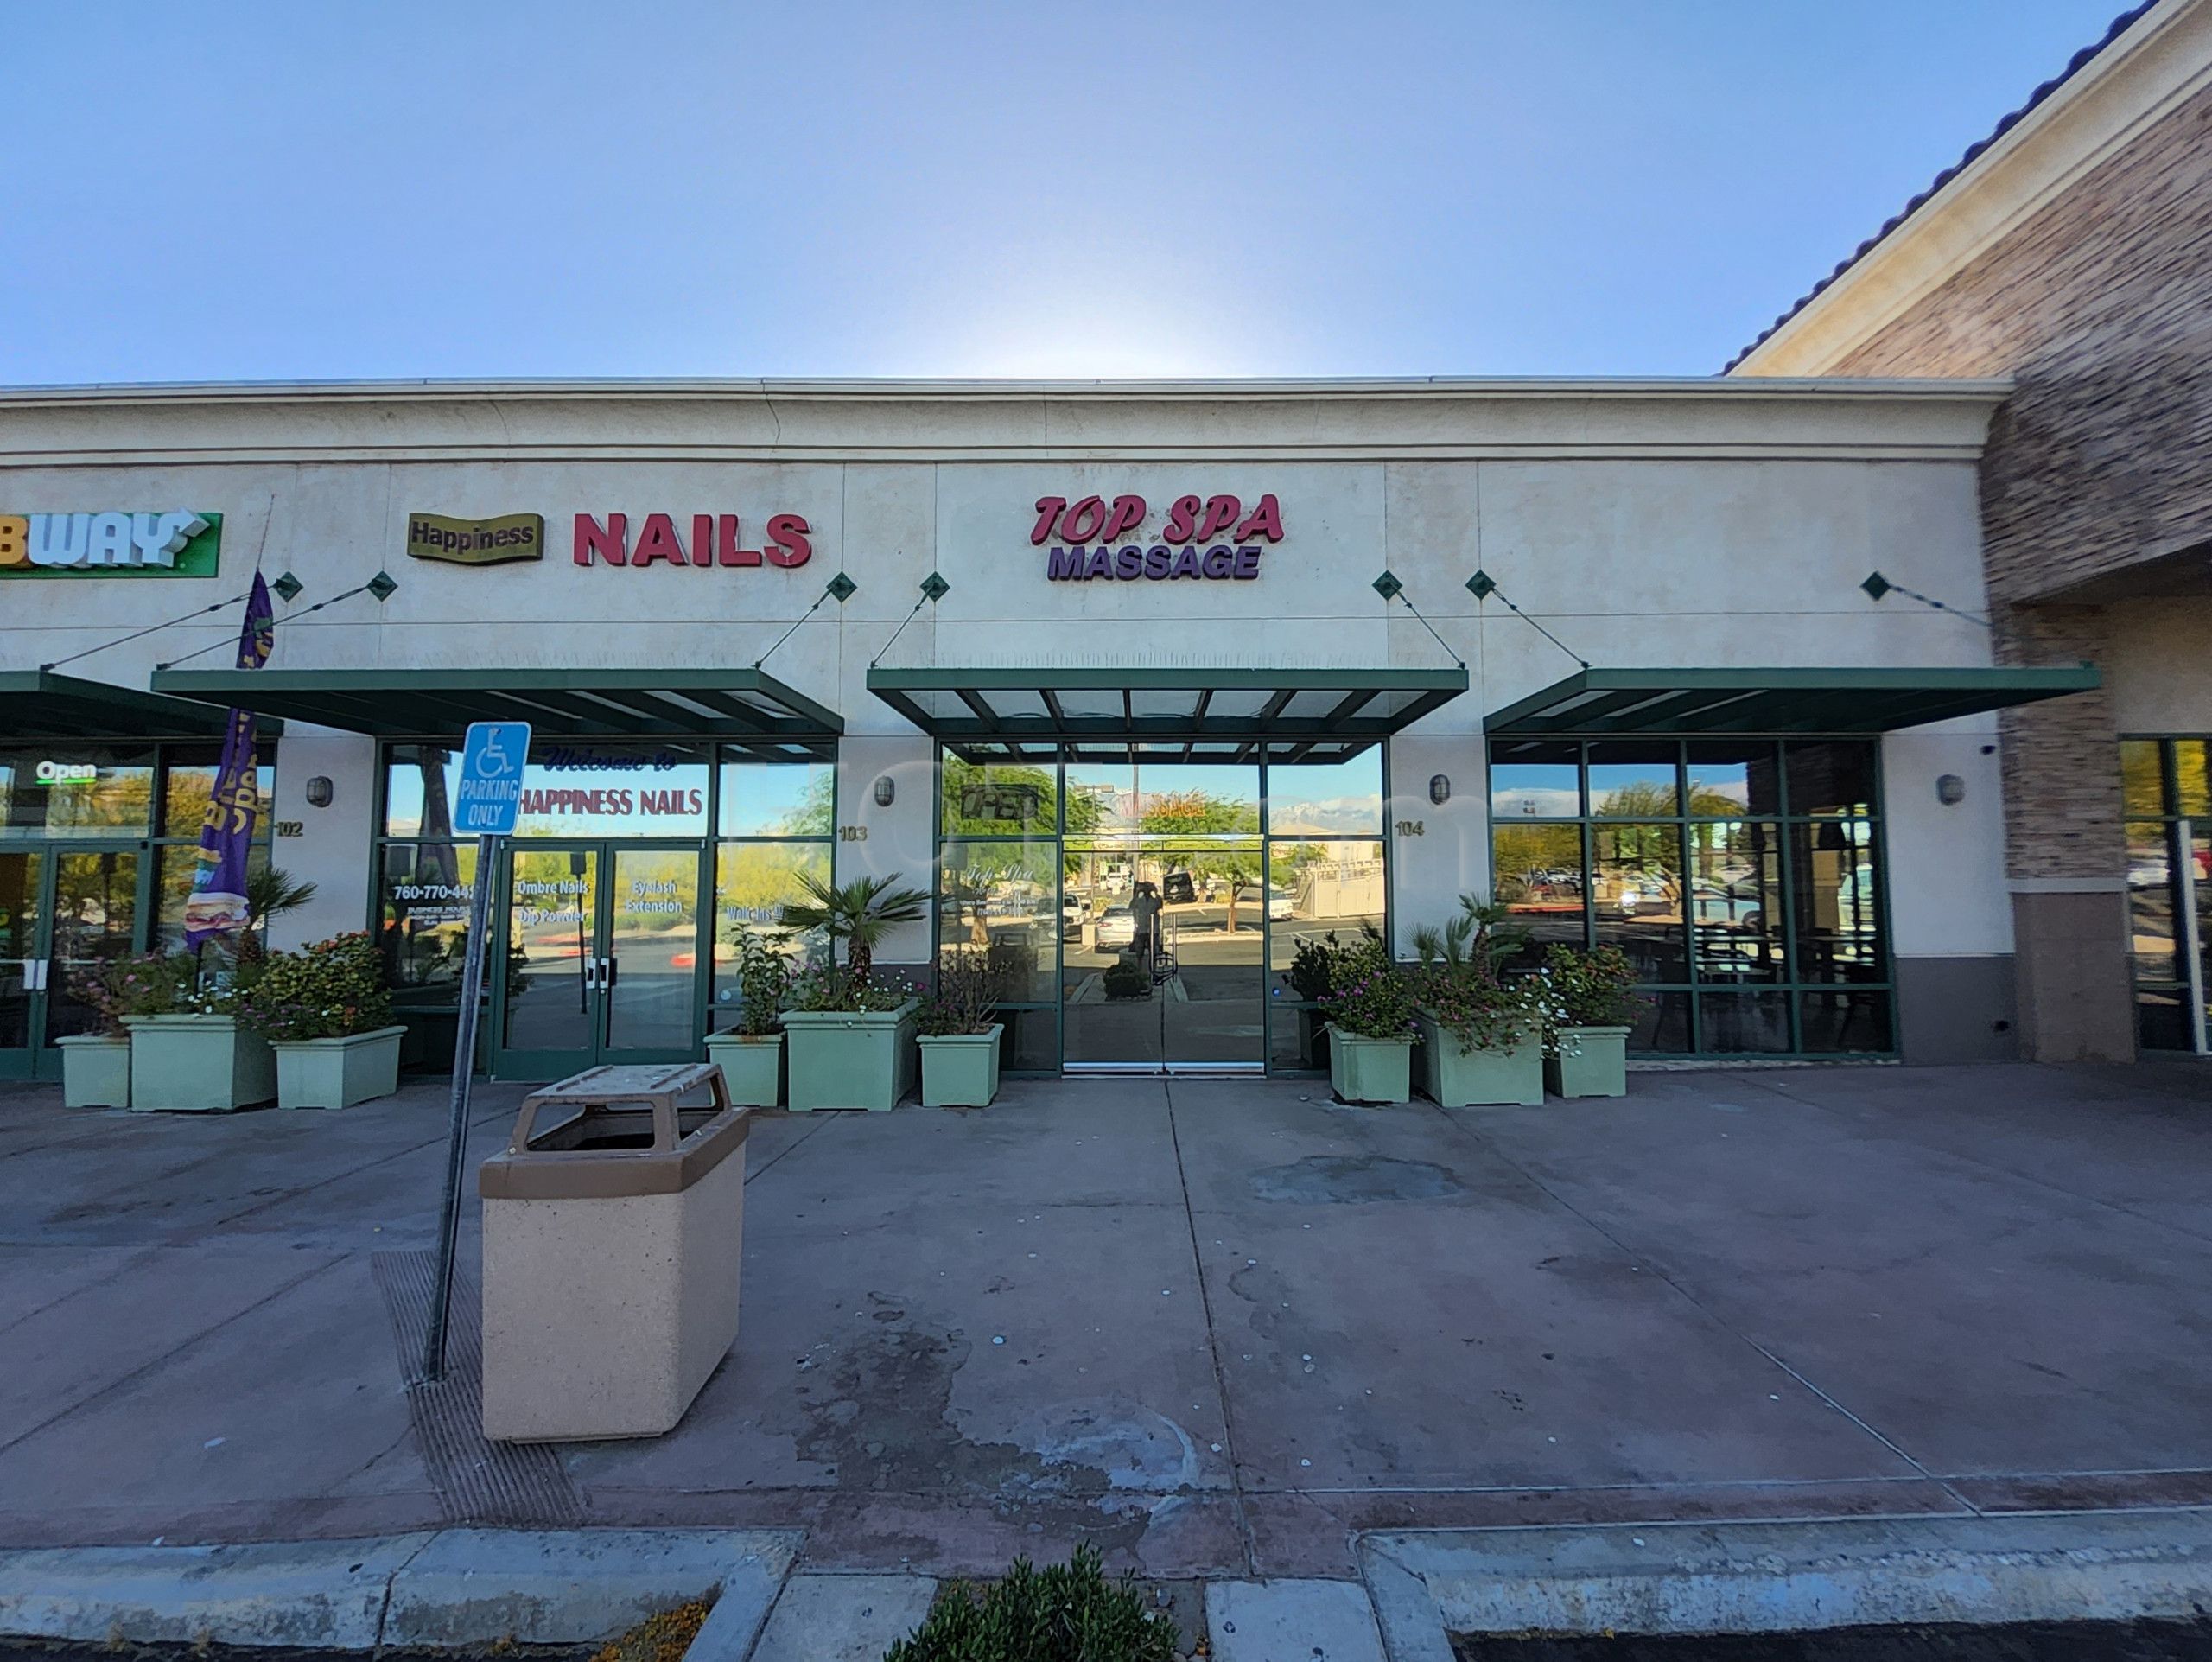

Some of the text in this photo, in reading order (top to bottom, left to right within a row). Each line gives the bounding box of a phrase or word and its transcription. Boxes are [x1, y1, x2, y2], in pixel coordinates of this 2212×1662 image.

[1031, 494, 1284, 545] TOP SPA
[410, 520, 534, 556] Happiness
[574, 513, 812, 568] NAILS
[1047, 545, 1262, 581] MASSAGE
[37, 761, 97, 786] Open
[461, 780, 518, 801] PARKING
[518, 789, 702, 815] HAPPINESS NAILS
[468, 804, 503, 826] ONLY
[276, 821, 304, 837] 102
[838, 825, 868, 842] 103
[1395, 821, 1425, 837] 104
[518, 879, 589, 895] Ombre Nails
[632, 880, 677, 896] Eyelash
[519, 909, 587, 926] Dip Powder
[626, 900, 683, 914] Extension
